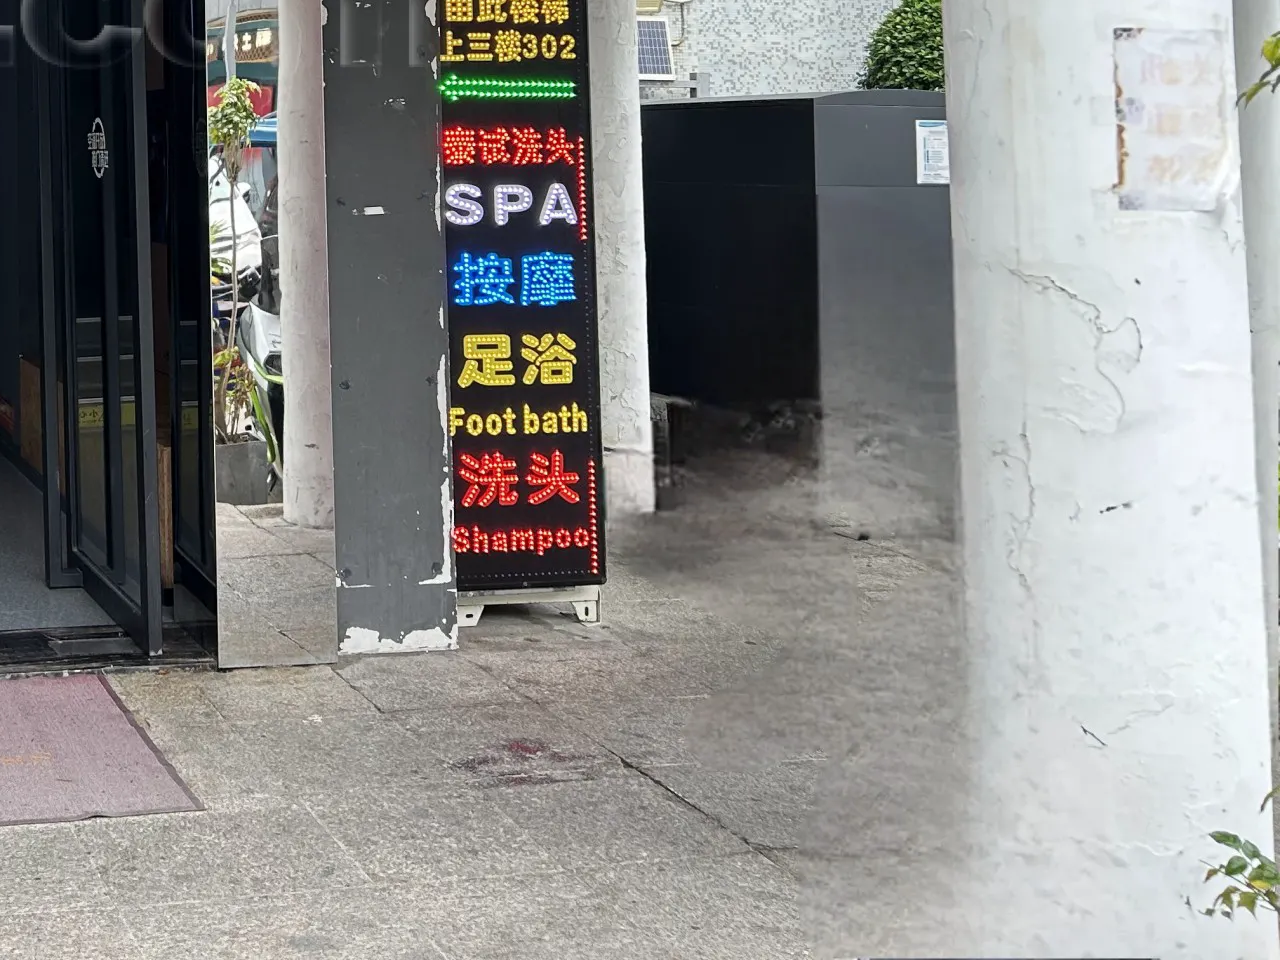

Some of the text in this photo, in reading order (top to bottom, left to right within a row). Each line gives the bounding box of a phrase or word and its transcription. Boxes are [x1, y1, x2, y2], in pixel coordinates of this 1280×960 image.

[439, 28, 577, 63] 上三楼302
[444, 183, 578, 226] SPA
[452, 251, 578, 306] 按摩
[457, 332, 578, 389] 足浴
[448, 402, 588, 437] Foot bath
[458, 449, 580, 508] 洗头
[451, 525, 589, 556] Shampoo
